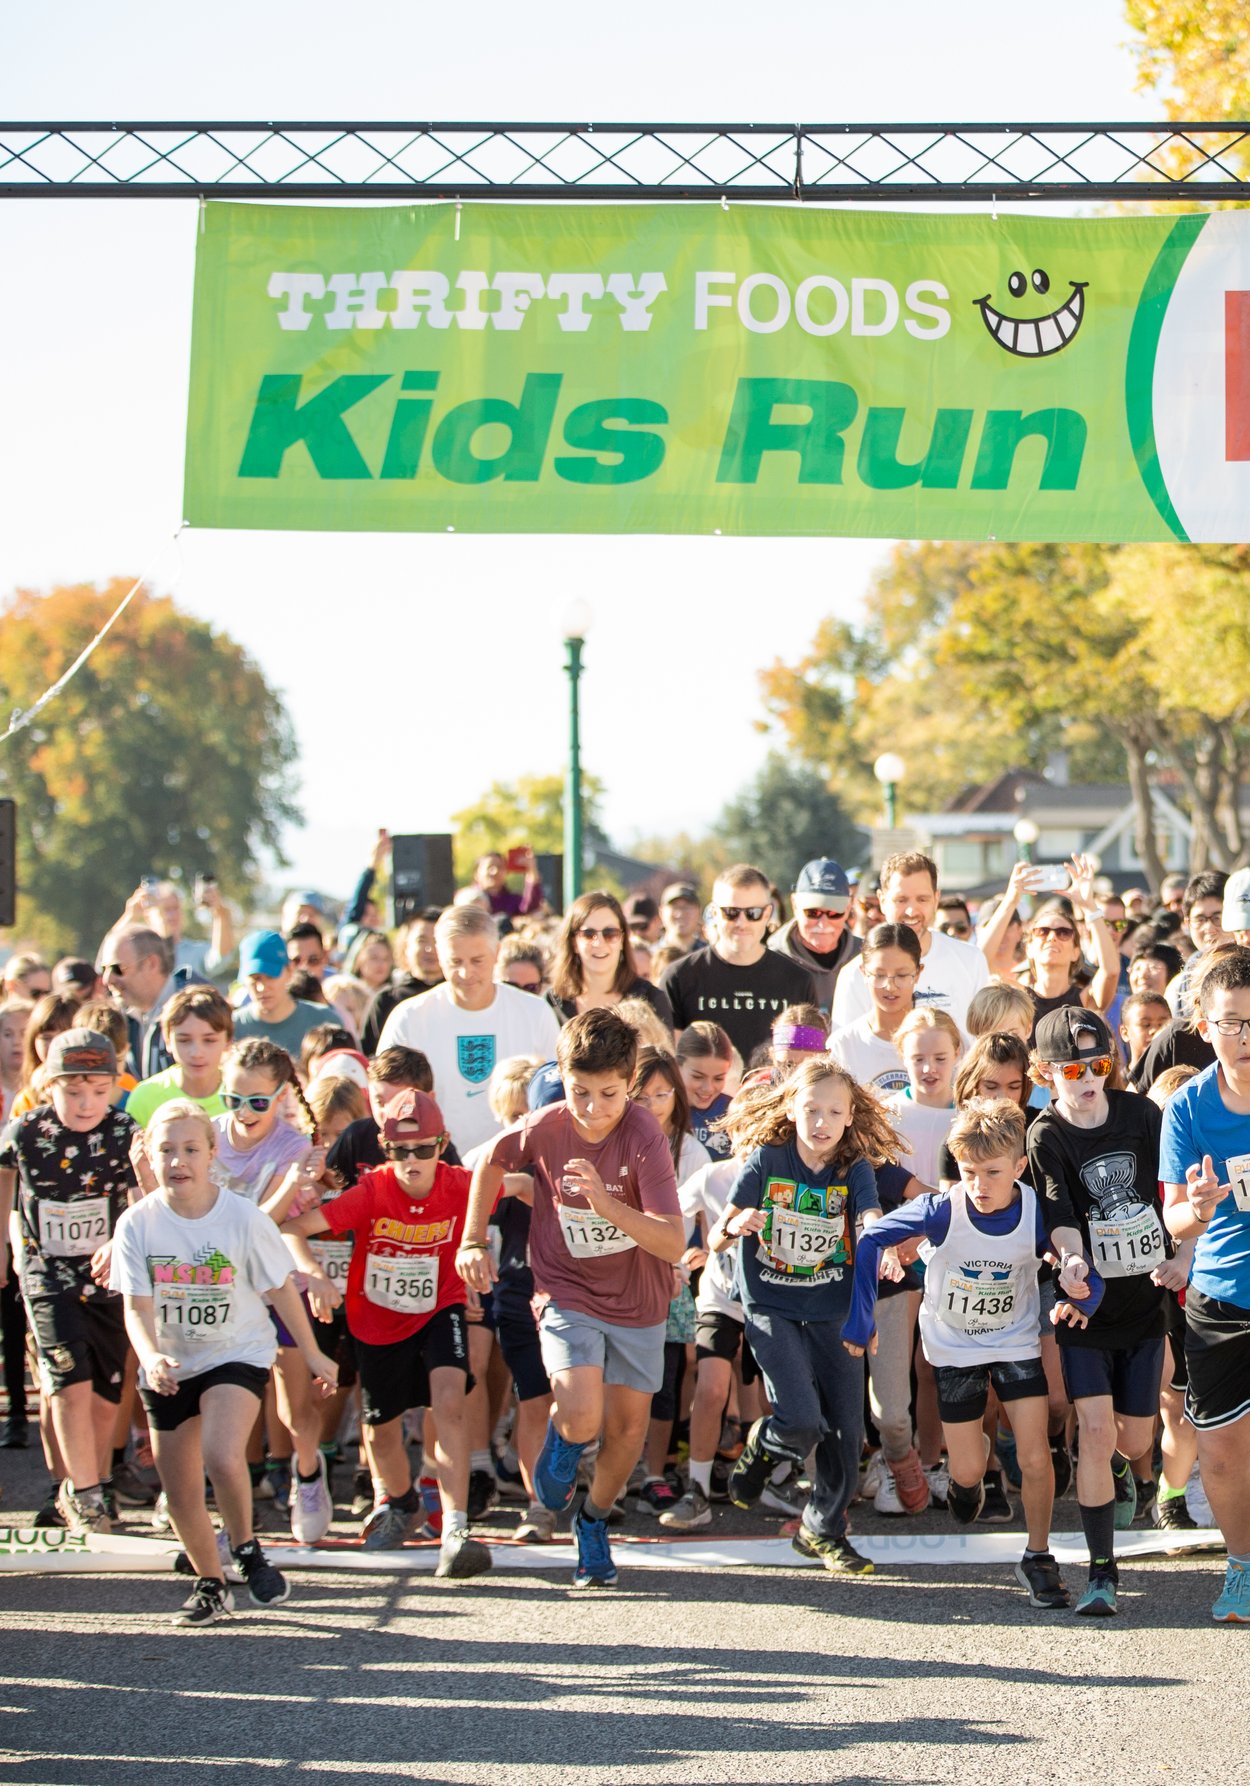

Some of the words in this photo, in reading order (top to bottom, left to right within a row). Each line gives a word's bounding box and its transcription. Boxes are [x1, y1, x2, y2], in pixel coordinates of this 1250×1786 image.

[267, 271, 667, 332] THRIFTY
[694, 272, 952, 340] FOODS
[238, 371, 669, 484] Kids
[715, 377, 1087, 491] Run
[46, 1217, 107, 1241] 11072
[373, 1216, 451, 1243] CHIEFS
[566, 1225, 628, 1244] 1132
[776, 1228, 840, 1253] 11326
[1098, 1227, 1161, 1261] 11185
[759, 1267, 844, 1287] MINECRAFT
[964, 1260, 1013, 1270] VICTORIA
[371, 1273, 433, 1298] 11356
[160, 1303, 231, 1326] 11087
[948, 1292, 1014, 1315] 11438
